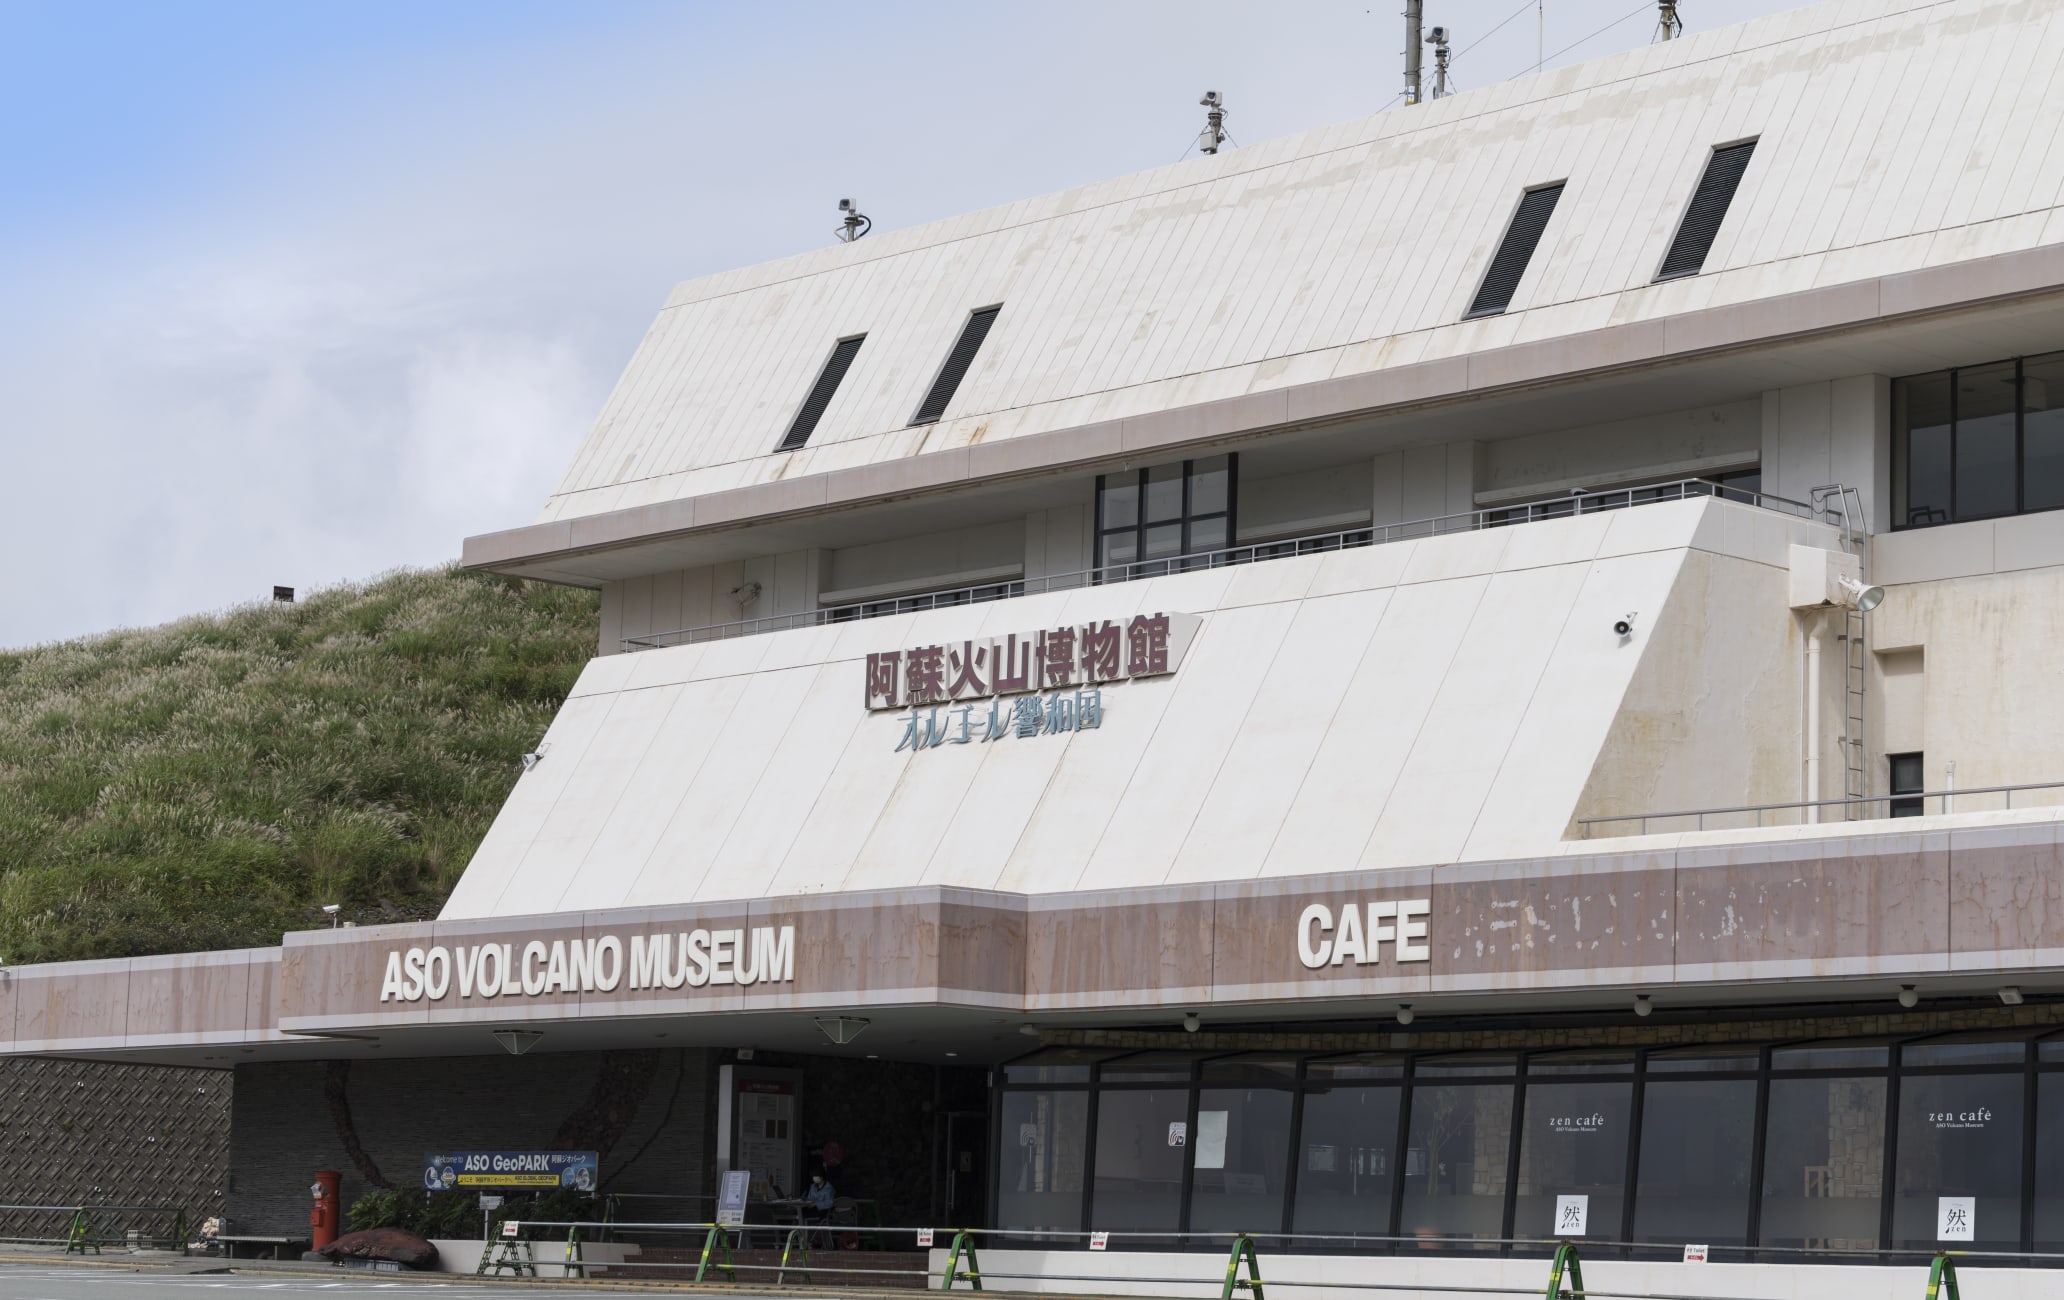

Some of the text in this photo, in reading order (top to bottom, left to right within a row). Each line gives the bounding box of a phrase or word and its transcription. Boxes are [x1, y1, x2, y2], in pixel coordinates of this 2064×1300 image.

[865, 612, 1172, 709] 阿蘇火山博物館
[894, 690, 1102, 752] オルゴール響和国
[381, 926, 796, 1001] ASO VOLCANO MUSEUM
[1298, 898, 1431, 968] CAFE
[1549, 1117, 1571, 1126] zen
[1928, 1112, 1953, 1121] zen
[464, 1154, 550, 1171] ASO GeoPARK
